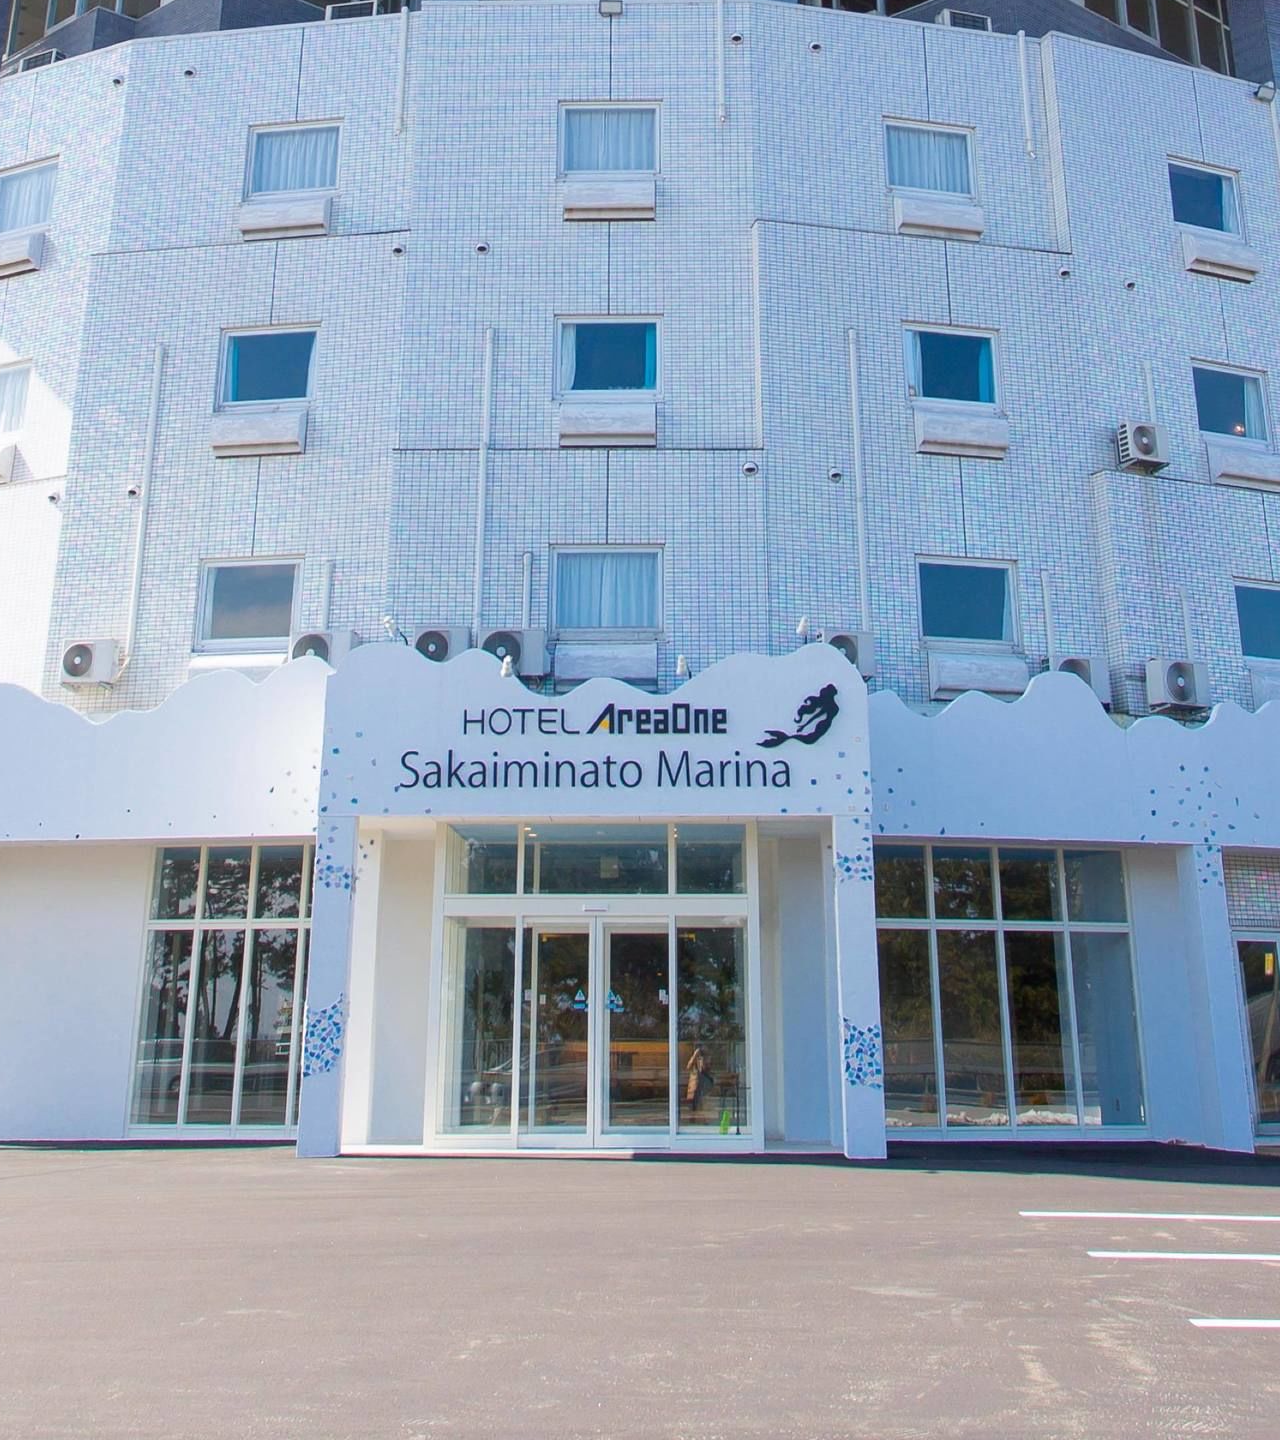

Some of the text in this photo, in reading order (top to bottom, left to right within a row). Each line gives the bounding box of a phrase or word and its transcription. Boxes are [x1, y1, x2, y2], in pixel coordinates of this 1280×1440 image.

[463, 703, 728, 735] HOTEL AreaOne
[398, 749, 791, 789] Sakaiminato Marina
